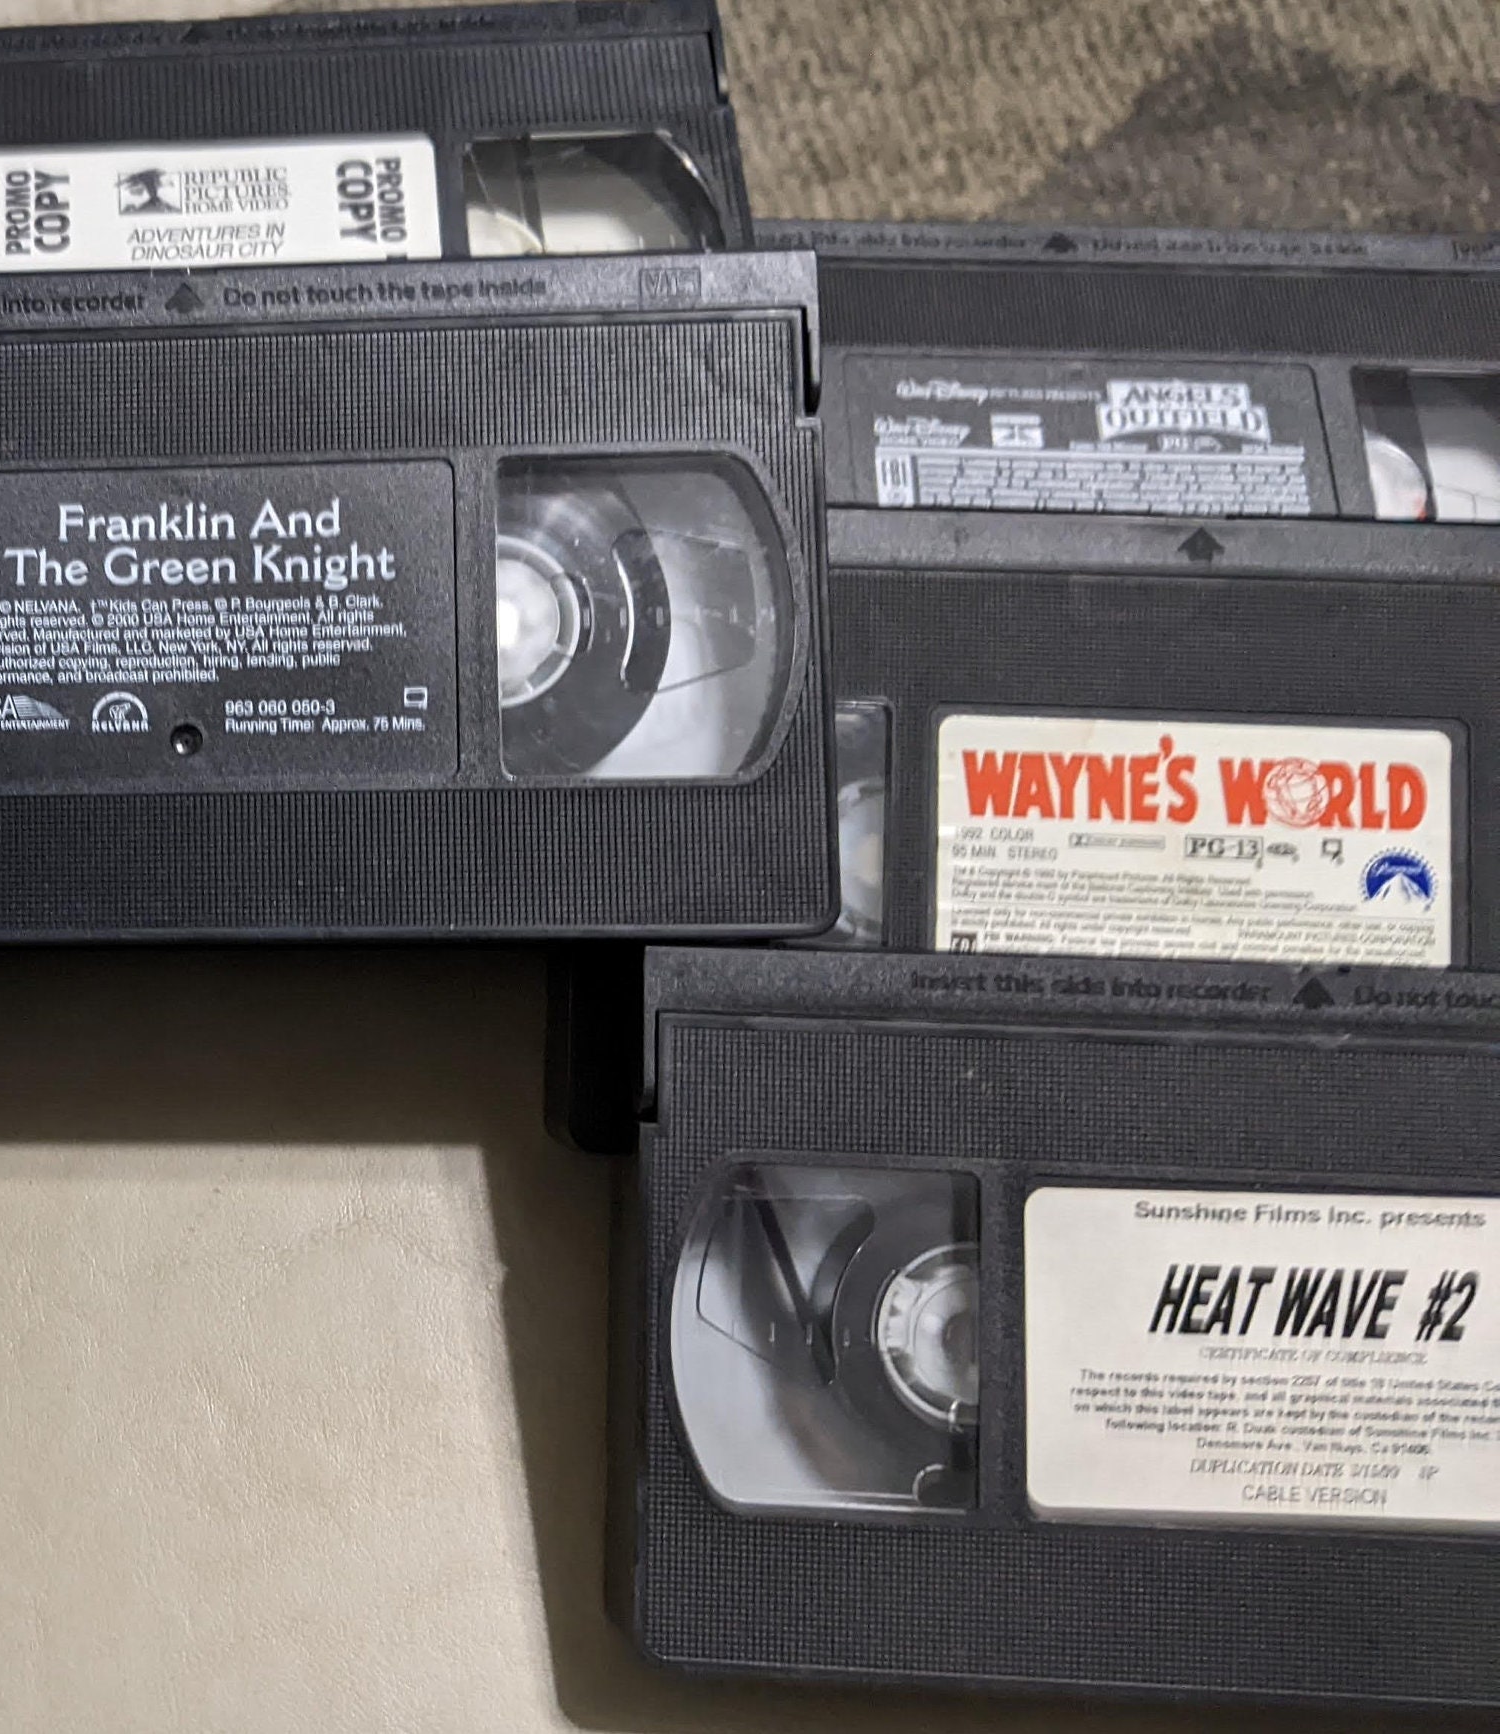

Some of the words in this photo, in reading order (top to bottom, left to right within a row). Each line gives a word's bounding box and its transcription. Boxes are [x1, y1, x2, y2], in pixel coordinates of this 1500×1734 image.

[184, 166, 287, 187] REPUBLIC
[184, 183, 288, 200] PICTURES
[336, 158, 379, 244] COPY
[375, 156, 409, 245] PROMO
[6, 169, 31, 256] PROMO
[34, 169, 71, 255] COPY
[185, 199, 235, 215] HOME
[238, 197, 289, 213] VIDEO
[127, 224, 261, 245] ADVENTURES
[266, 222, 286, 240] IN
[131, 243, 237, 262] DINOSAUR
[240, 241, 285, 258] CITY
[1, 294, 48, 313] into
[54, 293, 145, 313] recorder
[222, 287, 257, 307] Do
[261, 285, 302, 306] not
[306, 283, 373, 304] touch
[377, 281, 415, 302] the
[421, 280, 475, 302] tape
[479, 277, 546, 298] inside
[58, 500, 236, 542] Franklin
[250, 497, 341, 540] And
[4, 547, 89, 586] The
[104, 546, 237, 586] Green
[252, 542, 396, 589] Knight
[14, 600, 81, 614] NELVANA.
[142, 599, 168, 613] Can
[346, 594, 384, 609] Clark.
[30, 614, 88, 627] reserved.
[107, 614, 139, 627] 2000
[144, 613, 173, 627] USA
[177, 612, 216, 626] Home
[318, 610, 334, 624] All
[339, 609, 374, 625] rights
[33, 628, 120, 642] Manufactured
[123, 627, 147, 640] and
[151, 626, 211, 640] marketed
[215, 625, 231, 642] by
[235, 625, 265, 638] USA
[269, 624, 308, 637] Home
[34, 642, 47, 655] of
[51, 641, 80, 655] USA
[159, 640, 187, 654] New
[190, 640, 221, 655] York,
[252, 639, 269, 653] All
[273, 638, 308, 654] rights
[313, 637, 373, 652] reserved.
[59, 656, 111, 672] copying,
[115, 654, 199, 671] reproduction,
[204, 653, 243, 670] hiring,
[247, 652, 298, 669] lending,
[302, 651, 341, 669] public
[58, 670, 82, 684] and
[86, 669, 149, 684] broadcast
[152, 667, 220, 686] prohibited.
[225, 700, 254, 717] 963
[1, 718, 70, 731] ENTERTAINMENT
[225, 717, 277, 735] Running
[322, 716, 370, 734] Approx.
[393, 715, 426, 731] Mins.
[961, 734, 1199, 824] WAYNE'S
[1218, 757, 1428, 831] WORLD
[989, 827, 1034, 842] COLOR
[1007, 846, 1058, 862] STEREO
[1190, 837, 1259, 859] PG-13
[1134, 1200, 1248, 1224] Sunshine
[1254, 1203, 1321, 1225] Films
[1327, 1204, 1371, 1226] Inc.
[1380, 1207, 1486, 1232] presents
[1147, 1263, 1279, 1336] HEAT
[1274, 1266, 1408, 1342] WAVE
[1415, 1268, 1481, 1343] #2
[1241, 1484, 1300, 1502] CABLE
[1310, 1486, 1388, 1504] VERSION
